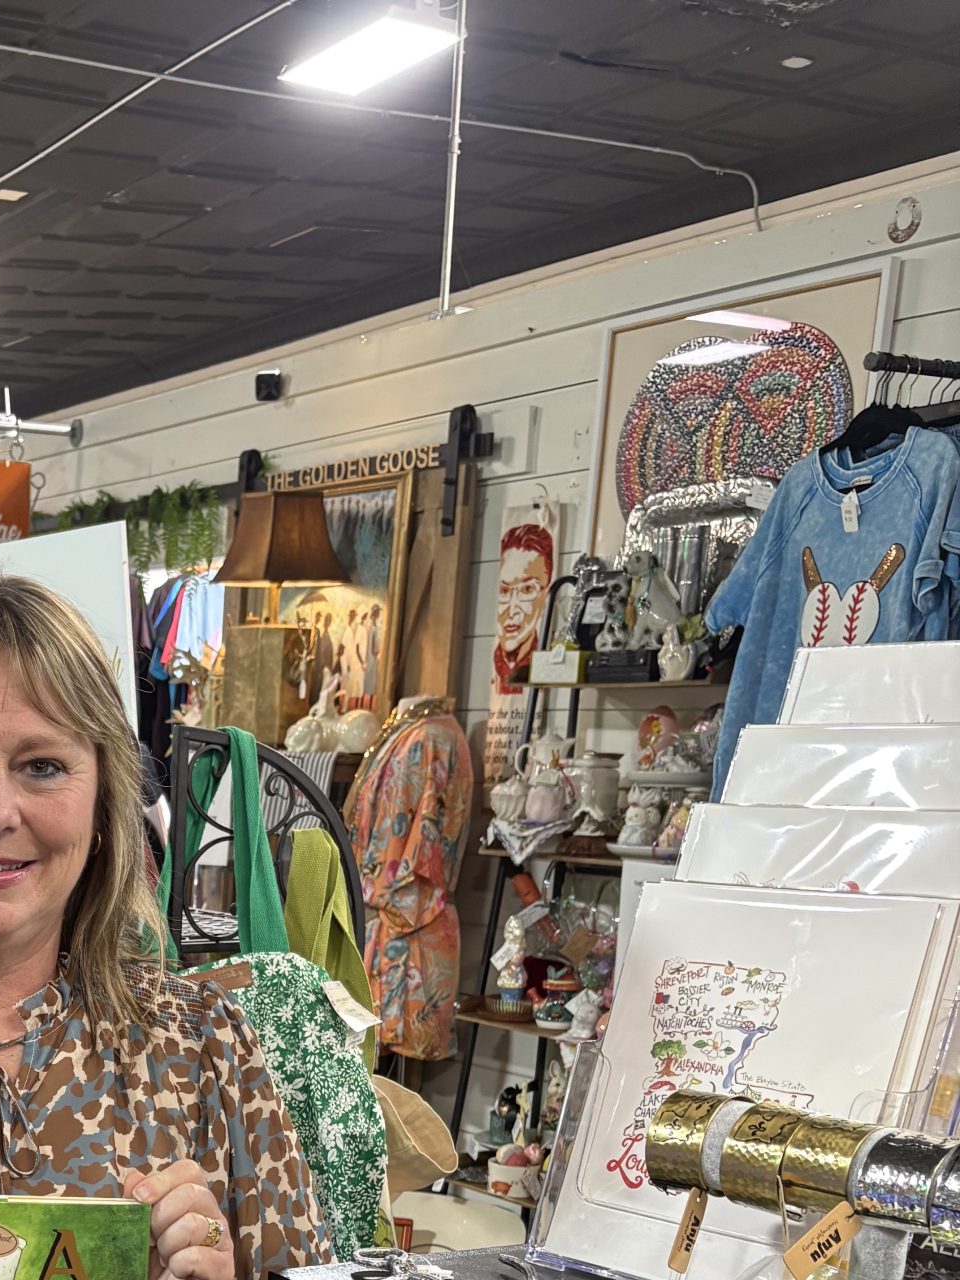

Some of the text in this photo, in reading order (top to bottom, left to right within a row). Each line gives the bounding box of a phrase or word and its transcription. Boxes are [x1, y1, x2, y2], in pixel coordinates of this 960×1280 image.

[267, 444, 440, 492] THE GOLDEN GOOSE
[655, 966, 711, 991] SHREVEPORT
[678, 984, 712, 998] BOSSIER
[747, 981, 786, 994] MONROE
[678, 997, 703, 1007] CITY
[656, 1015, 713, 1031] NATCHITOCHES
[675, 1059, 724, 1075] ALEXANDRIA
[740, 1072, 753, 1082] The
[684, 1214, 701, 1255] Anju
[810, 1227, 843, 1264] Anju
